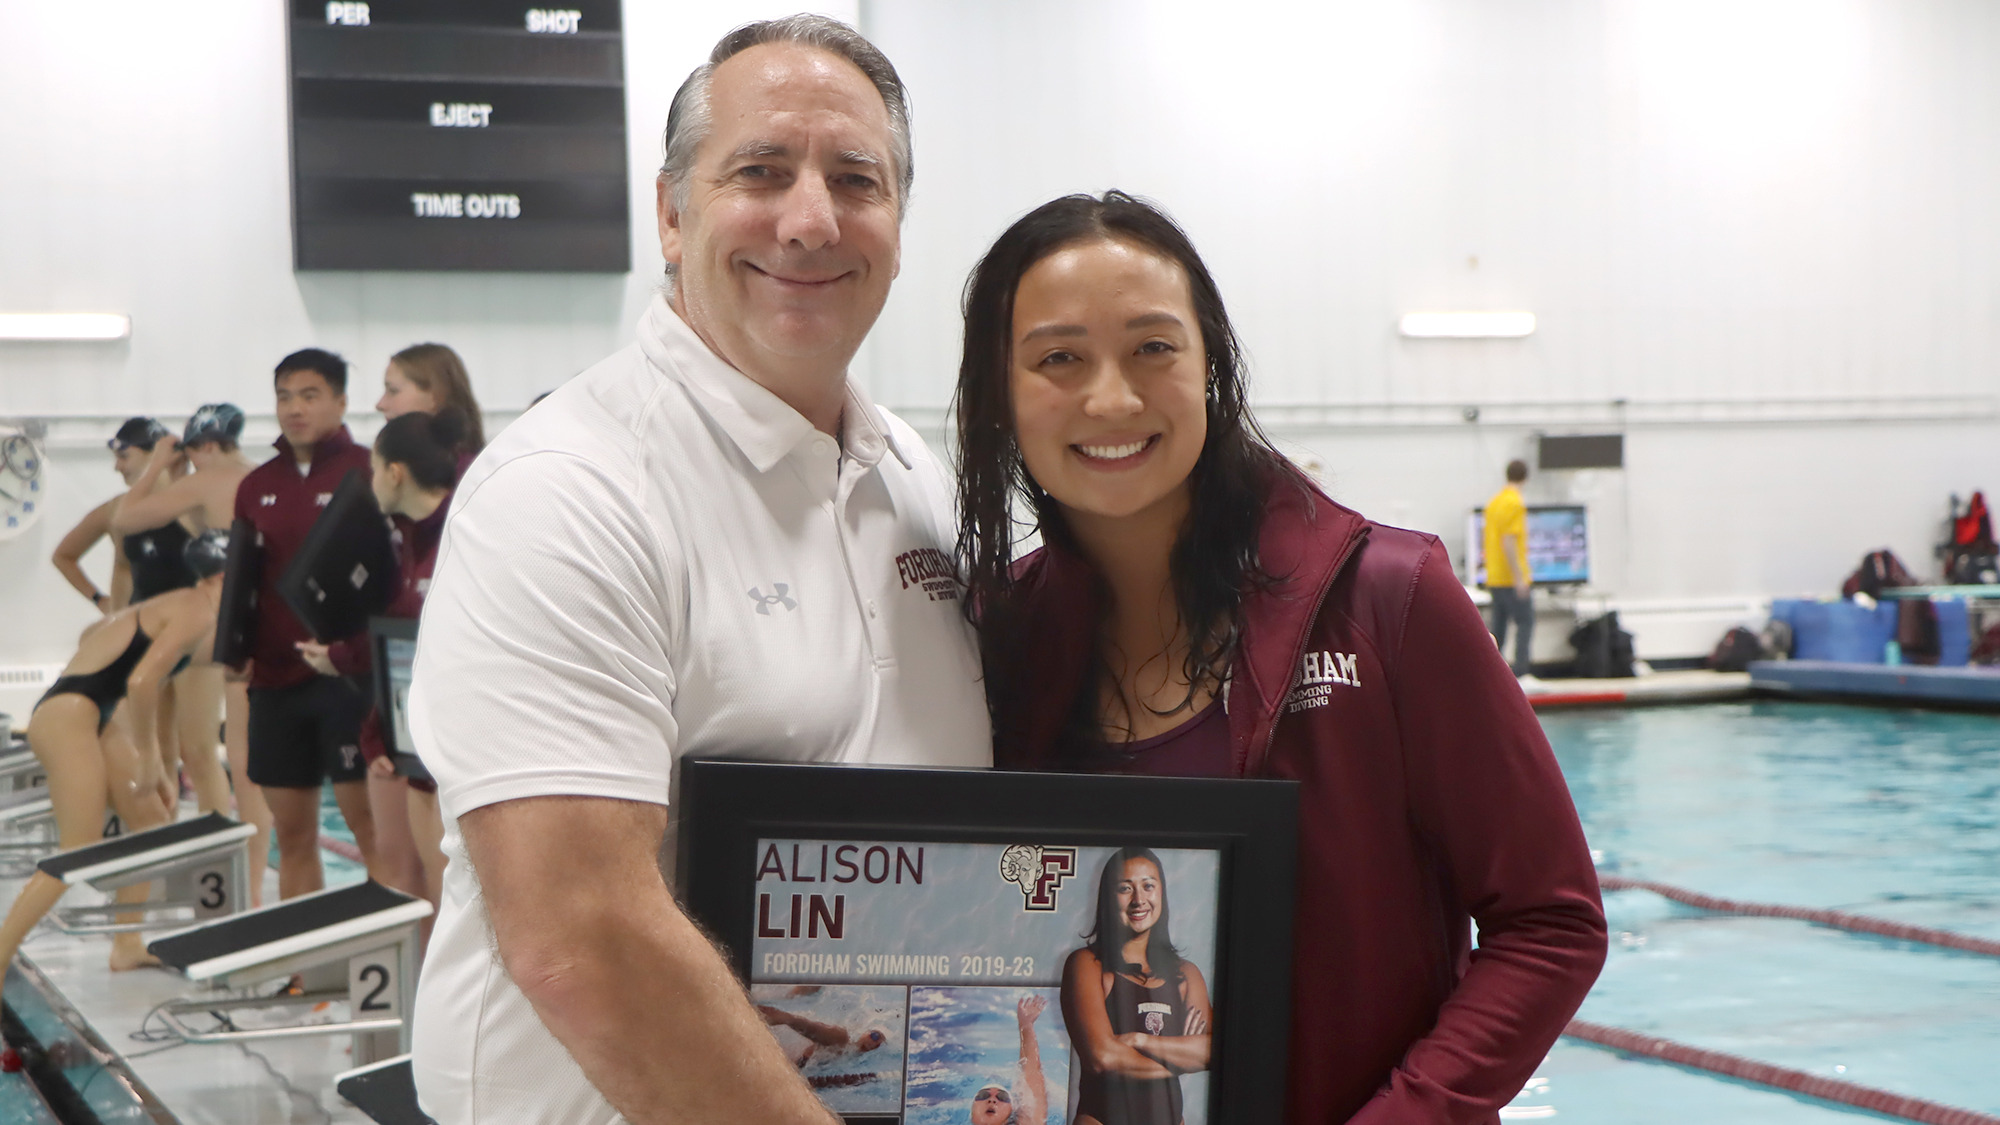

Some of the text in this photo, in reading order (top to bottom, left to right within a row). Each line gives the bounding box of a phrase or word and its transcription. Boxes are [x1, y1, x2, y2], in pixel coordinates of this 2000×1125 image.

[326, 1, 370, 26] PER
[525, 9, 582, 34] SHOT
[430, 102, 493, 127] EJECT
[411, 193, 521, 218] TIME OUTS
[1299, 651, 1361, 687] HAM
[1290, 696, 1329, 713] DIVING
[756, 843, 924, 885] ALISON
[201, 872, 226, 909] 3
[757, 892, 846, 940] LIN
[763, 952, 1034, 977] FORDHAM SWIMMING 2019-23
[359, 964, 391, 1011] 2
